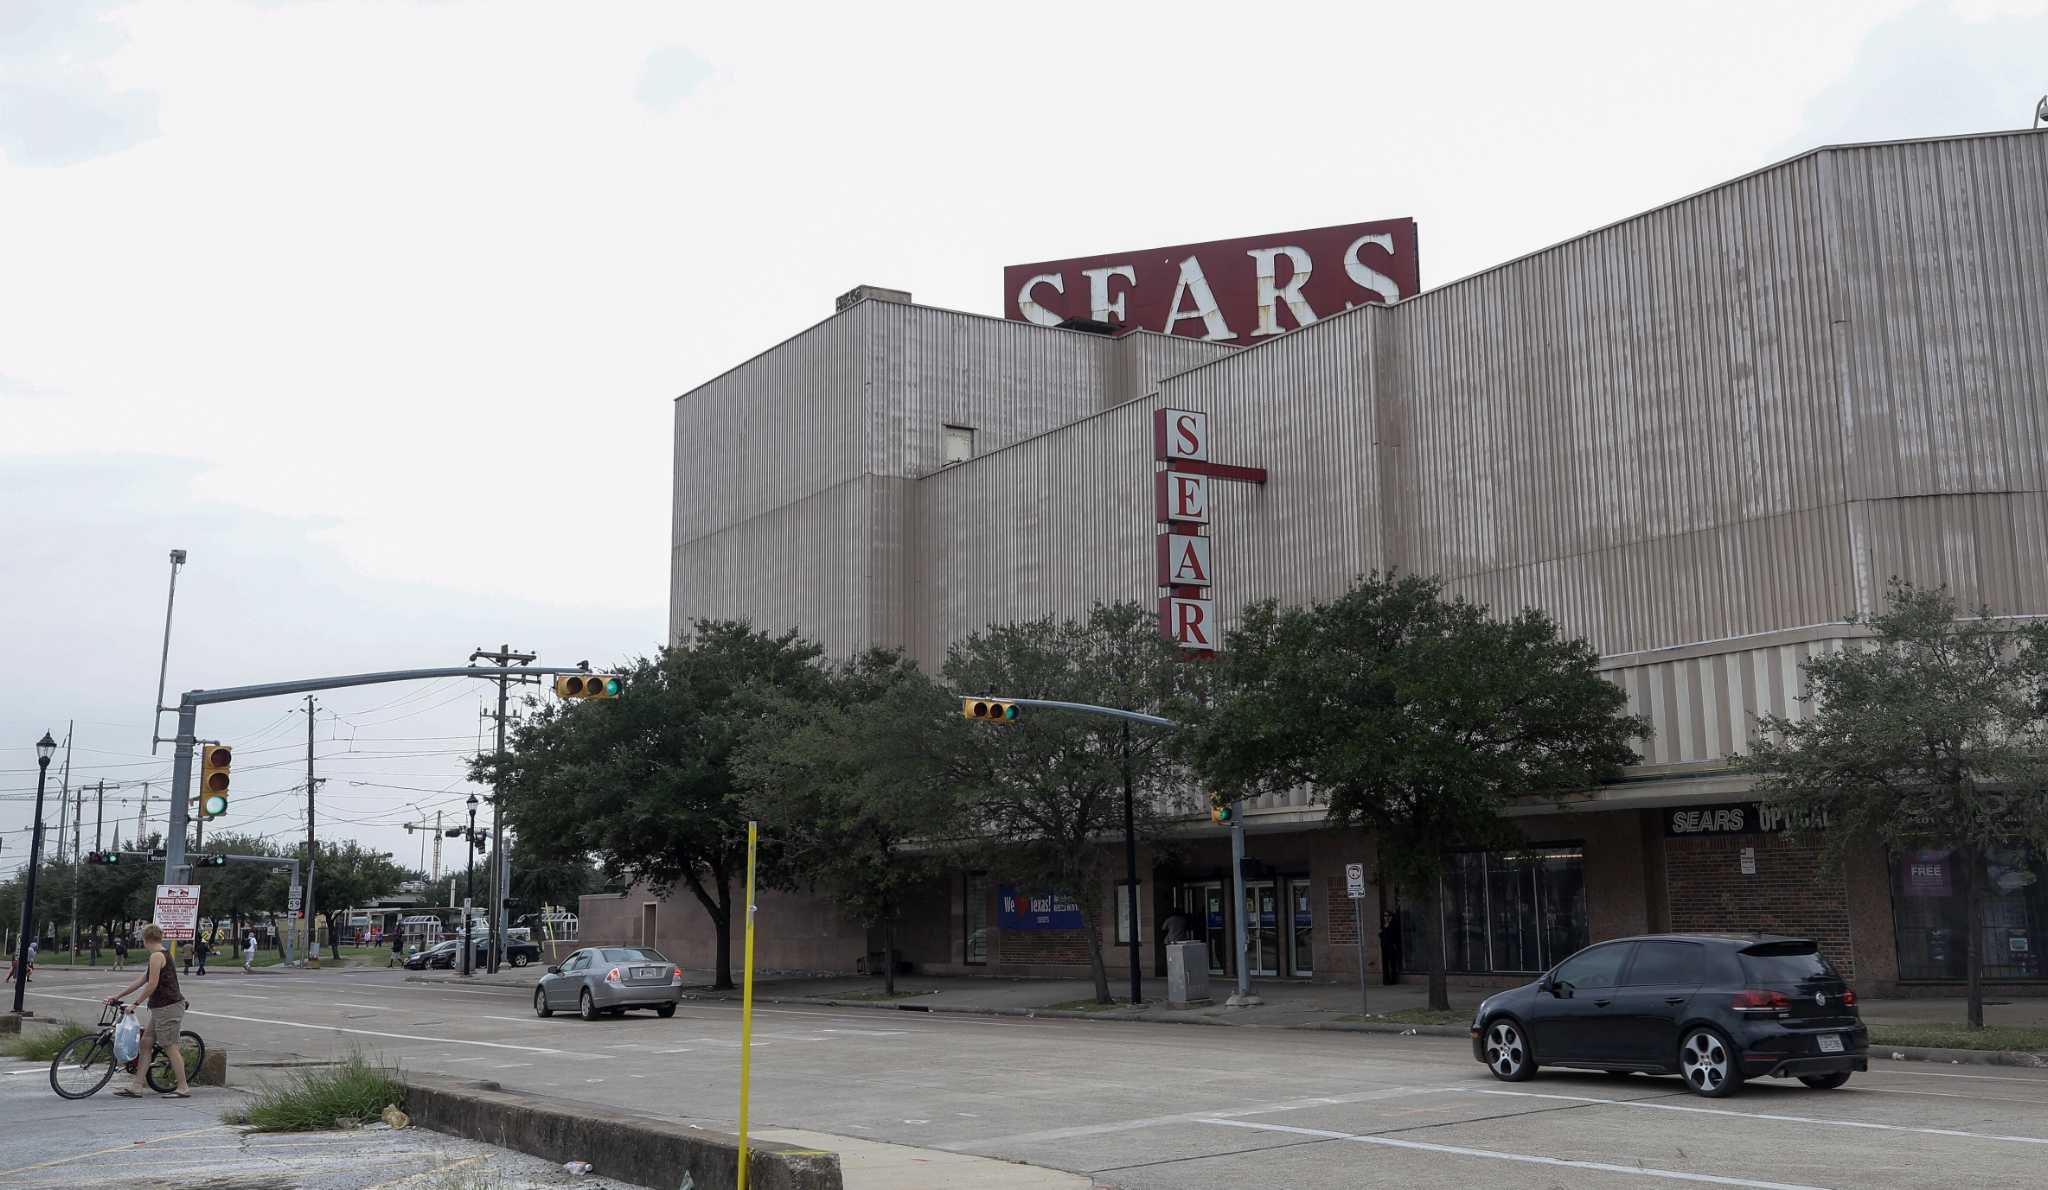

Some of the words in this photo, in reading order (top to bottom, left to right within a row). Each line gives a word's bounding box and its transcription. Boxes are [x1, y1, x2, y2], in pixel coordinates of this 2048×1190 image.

[1017, 232, 1401, 342] SEARS
[1174, 415, 1209, 645] SEAR
[1672, 808, 1744, 833] SEARS
[1911, 864, 1942, 877] FREE
[289, 900, 299, 908] 59
[1004, 896, 1015, 912] We
